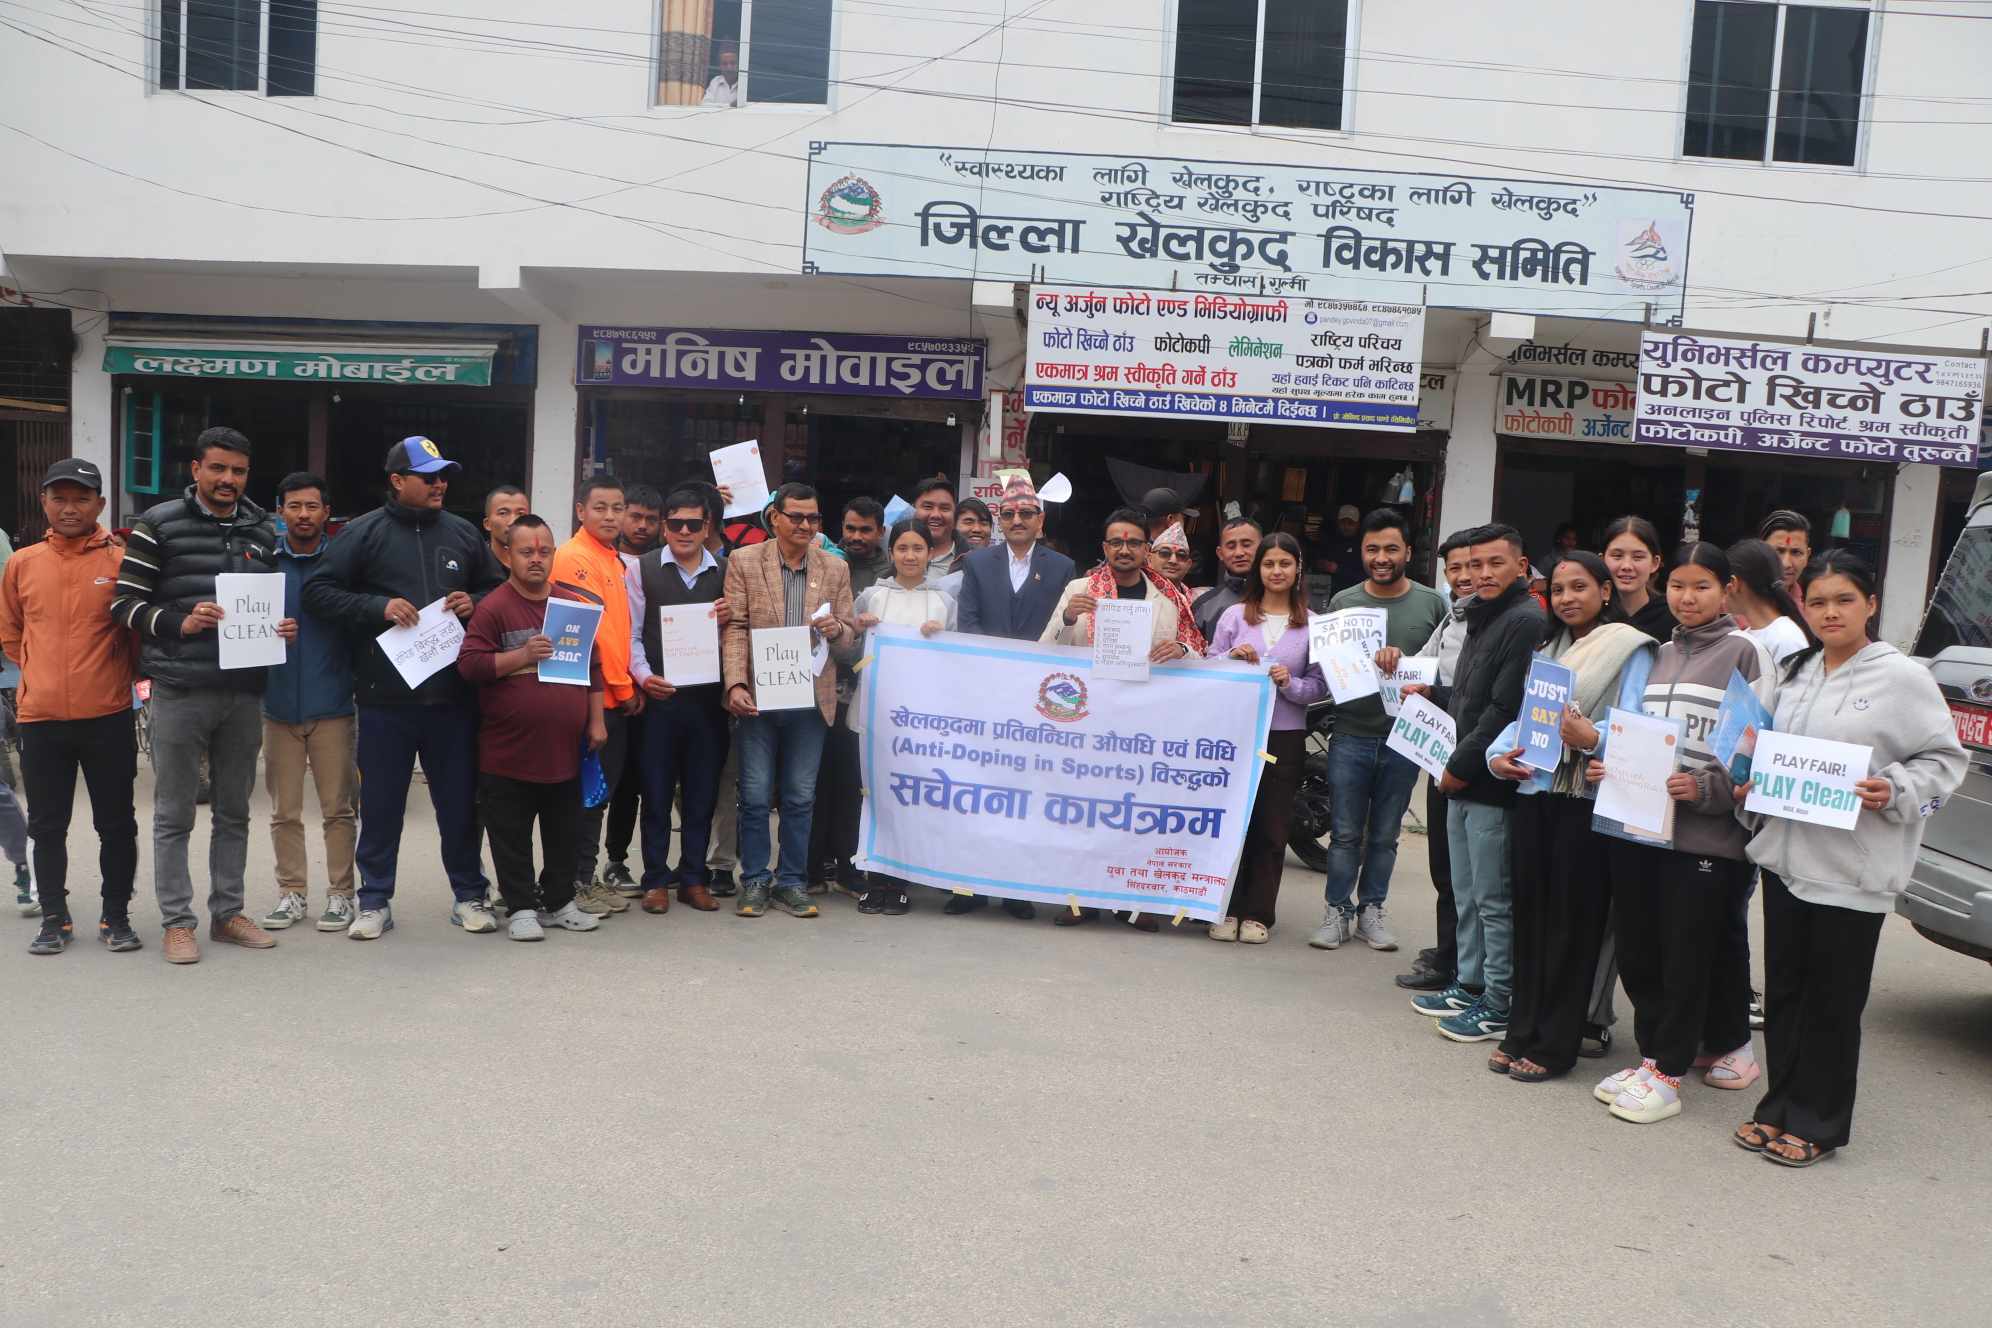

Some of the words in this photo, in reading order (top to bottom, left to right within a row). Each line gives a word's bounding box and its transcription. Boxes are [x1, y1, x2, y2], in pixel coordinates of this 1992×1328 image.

[1092, 162, 1149, 186] लागि
[1409, 181, 1476, 207] लागि
[1197, 192, 1293, 223] खेलकुद
[1311, 200, 1400, 228] परिषद
[914, 200, 1086, 254] जिल्ला
[1116, 212, 1296, 273] खेलकुद
[1317, 225, 1457, 277] विकास
[1471, 237, 1596, 286] समिति
[1036, 293, 1061, 318] न्यू
[1064, 288, 1107, 318] अर्जुन
[1113, 292, 1151, 316] फोटो
[1157, 298, 1189, 318] एण्ड
[1194, 295, 1288, 324] भिडियोग्राफी
[1043, 327, 1073, 350] फोटो
[1076, 328, 1109, 351] खिच्ने
[1154, 332, 1211, 355] फोटोकपी
[1358, 333, 1402, 351] परिचय
[133, 354, 281, 377] लक्ष्मण
[621, 331, 762, 382] मनिष
[1295, 353, 1335, 370] पत्रको
[1337, 355, 1364, 372] फर्म
[1368, 356, 1414, 375] भरिन्छ
[1643, 335, 1792, 373] युनिभर्सल
[1036, 362, 1089, 381] एकमात्र
[1093, 365, 1120, 382] श्रम
[1124, 362, 1176, 389] स्वीकृति
[1182, 366, 1207, 386] गर्ने
[1322, 374, 1350, 388] टिकट
[1080, 389, 1110, 407] फोटो
[1506, 377, 1590, 409] MRP
[1591, 383, 1637, 411] फो
[1641, 368, 1751, 404] फोटो
[1766, 375, 1886, 415] खिच्ने
[1900, 390, 1983, 422] ठाउँ
[1644, 403, 1732, 422] अनलाइन
[1741, 408, 1792, 427] पुलिस
[1859, 419, 1892, 434] श्रम
[1757, 431, 1831, 451] अर्जेन्ट
[1839, 437, 1898, 457] फोटो
[235, 594, 271, 619] Play
[223, 623, 279, 640] CLEAN
[766, 643, 799, 666] Play
[756, 669, 811, 687] CLEAN
[1528, 679, 1568, 703] JUST
[1416, 710, 1442, 731] PLAY
[1531, 706, 1559, 726] SAY
[890, 705, 986, 737] खेलकुदमा
[1092, 730, 1157, 756] औषधि
[1163, 739, 1189, 759] एवं
[1196, 738, 1237, 761] विधि
[1394, 718, 1430, 748] PLAY
[1530, 731, 1549, 748] NO
[892, 736, 1026, 772] (Anti-Doping
[1034, 754, 1053, 771] in
[1061, 757, 1145, 785] Sports)
[1773, 753, 1808, 770] PLAY
[1809, 759, 1847, 776] FAIR!
[890, 768, 1033, 820] सचेतना
[1044, 792, 1226, 839] कार्यक्रम
[1751, 771, 1796, 800] PLAY
[1801, 780, 1856, 812] Clean
